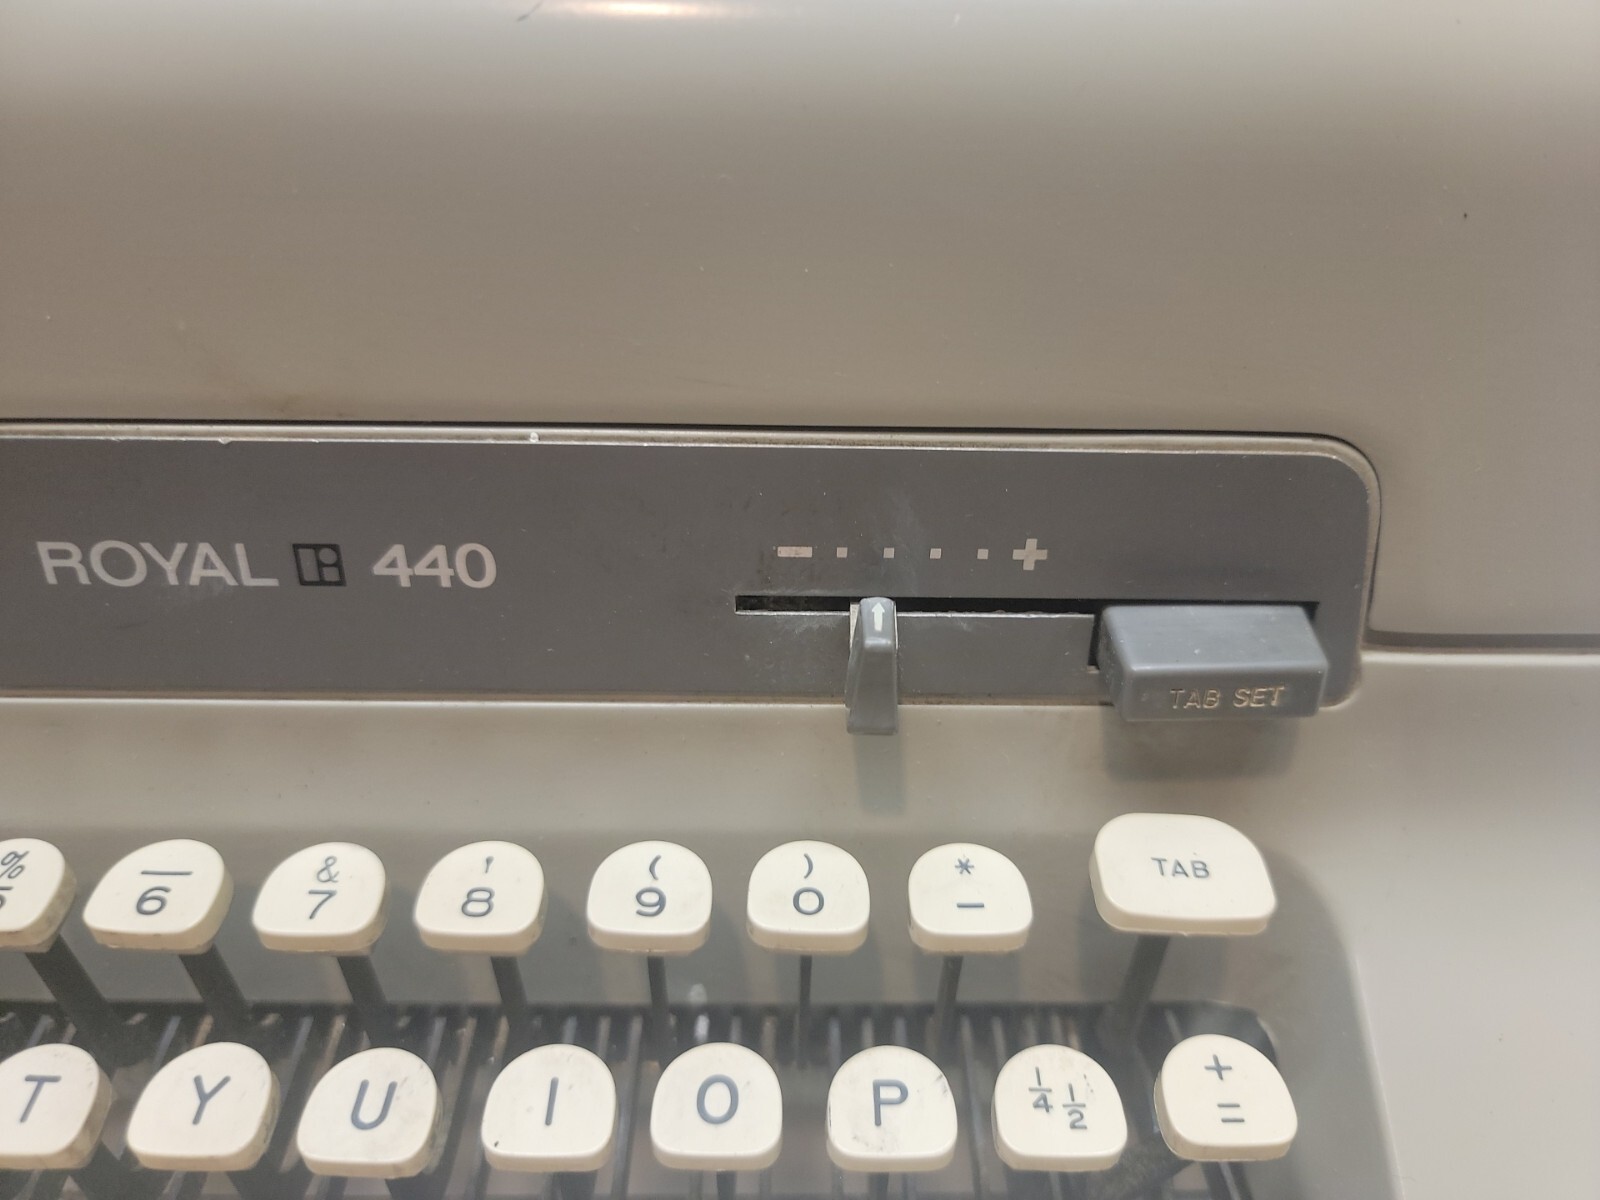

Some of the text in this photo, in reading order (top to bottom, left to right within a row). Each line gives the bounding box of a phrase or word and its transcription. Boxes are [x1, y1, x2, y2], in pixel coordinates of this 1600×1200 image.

[36, 540, 280, 588] ROYAL
[372, 542, 498, 589] 440
[1169, 686, 1285, 710] TAB SET
[316, 856, 340, 884] &
[1151, 856, 1211, 880] TAB
[136, 886, 171, 916] 6
[308, 889, 337, 920] 7
[461, 887, 496, 918] 8
[635, 886, 667, 917] 9
[19, 1074, 62, 1123] T
[192, 1075, 231, 1126] Y
[350, 1079, 399, 1131] U
[545, 1076, 559, 1127] I
[696, 1074, 739, 1126] O
[872, 1078, 909, 1128] P
